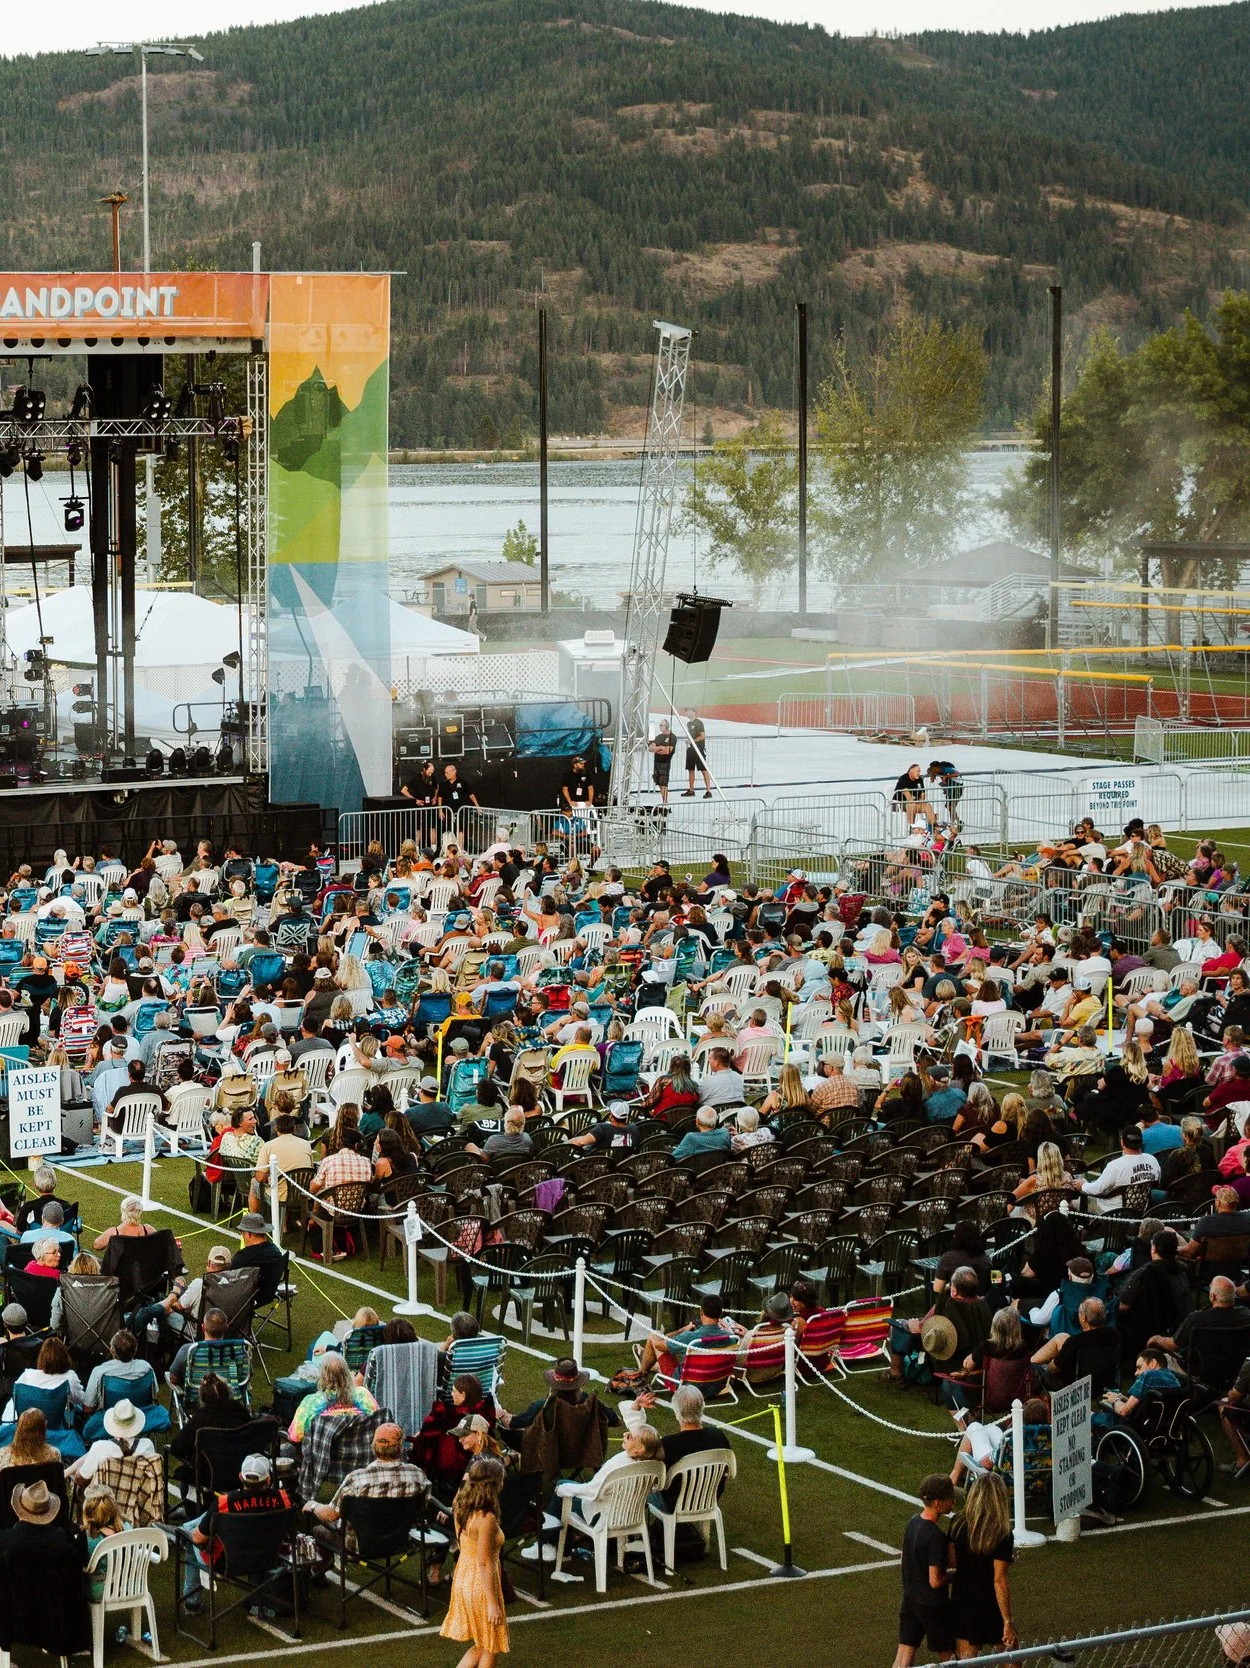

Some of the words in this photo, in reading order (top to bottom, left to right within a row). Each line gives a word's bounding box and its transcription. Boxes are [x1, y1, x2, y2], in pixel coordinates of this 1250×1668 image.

[1092, 781, 1111, 790] STAGE
[1113, 779, 1135, 789] PASSES
[1098, 790, 1130, 800] REQUIRED
[1089, 801, 1110, 810] BEYOND
[1122, 799, 1138, 808] POINT
[12, 1071, 58, 1086] AISLES
[16, 1088, 55, 1102] MUST
[27, 1104, 44, 1117] BE
[19, 1119, 53, 1134] KEPT
[14, 1135, 57, 1151] CLEAR
[1056, 1413, 1070, 1437] KEPT
[1070, 1405, 1087, 1429] CLEAR
[1067, 1433, 1076, 1452] NO
[1058, 1446, 1086, 1476] STANDING
[1059, 1483, 1086, 1513] STOPPING
